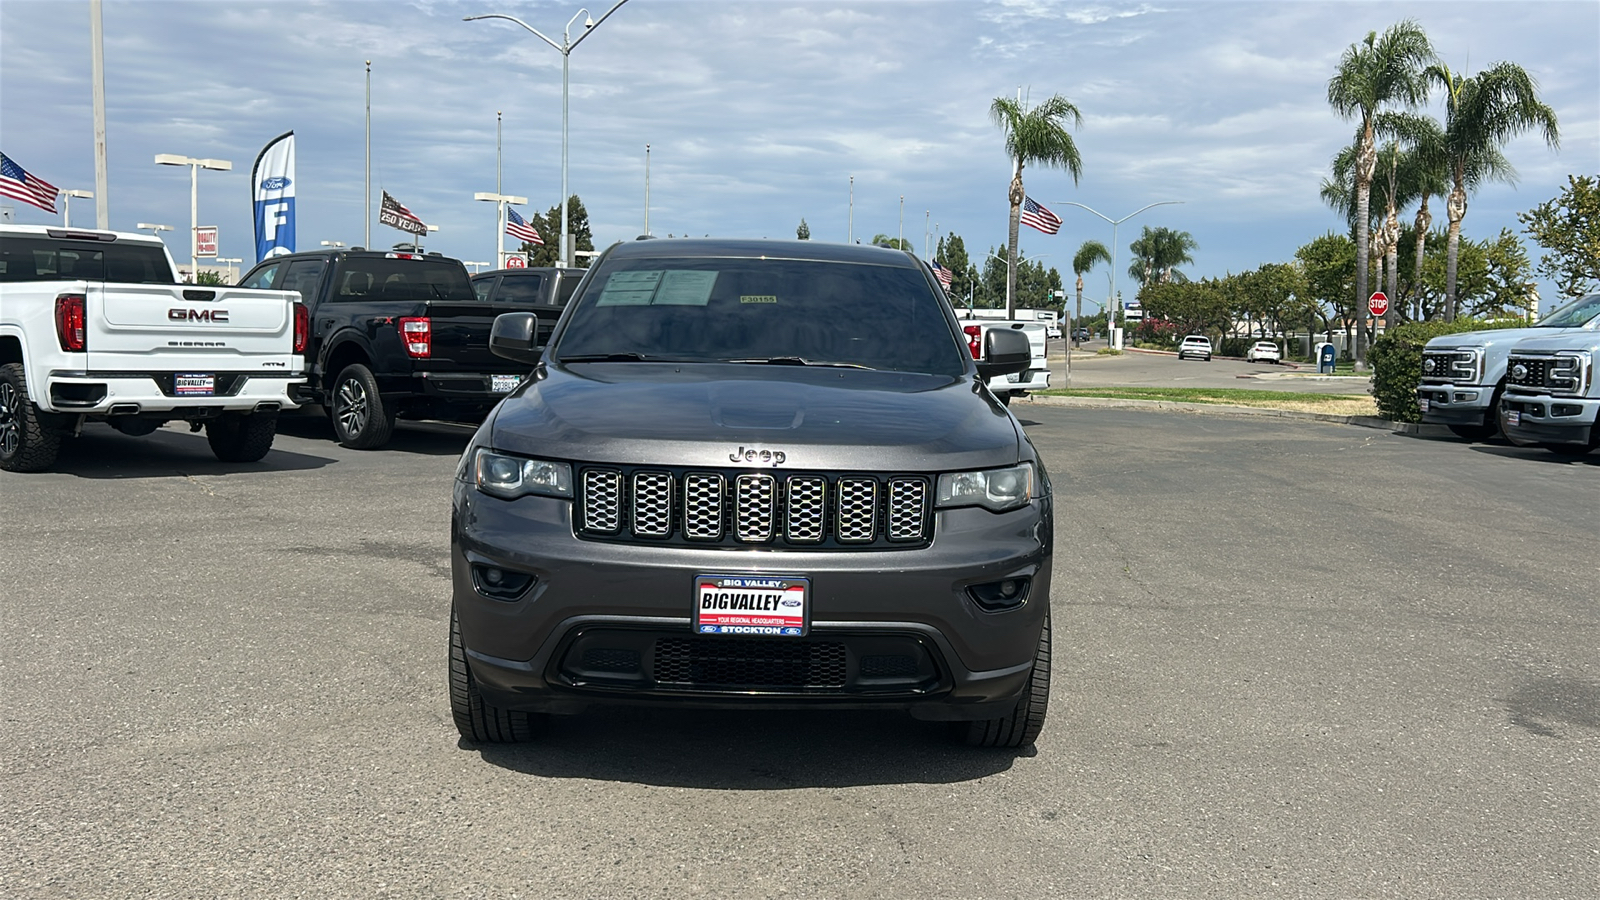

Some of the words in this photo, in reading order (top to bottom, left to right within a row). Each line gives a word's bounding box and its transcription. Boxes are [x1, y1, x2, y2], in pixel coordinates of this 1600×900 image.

[381, 212, 397, 224] 250
[1370, 299, 1387, 309] STOP
[168, 308, 229, 323] GMC
[177, 379, 206, 387] BIGVALLEY
[729, 446, 786, 467] Jeep
[723, 579, 742, 587] BIG
[744, 580, 782, 588] VALLEY
[702, 593, 782, 611] BIGVALLEY
[721, 626, 781, 634] STOCKTON
